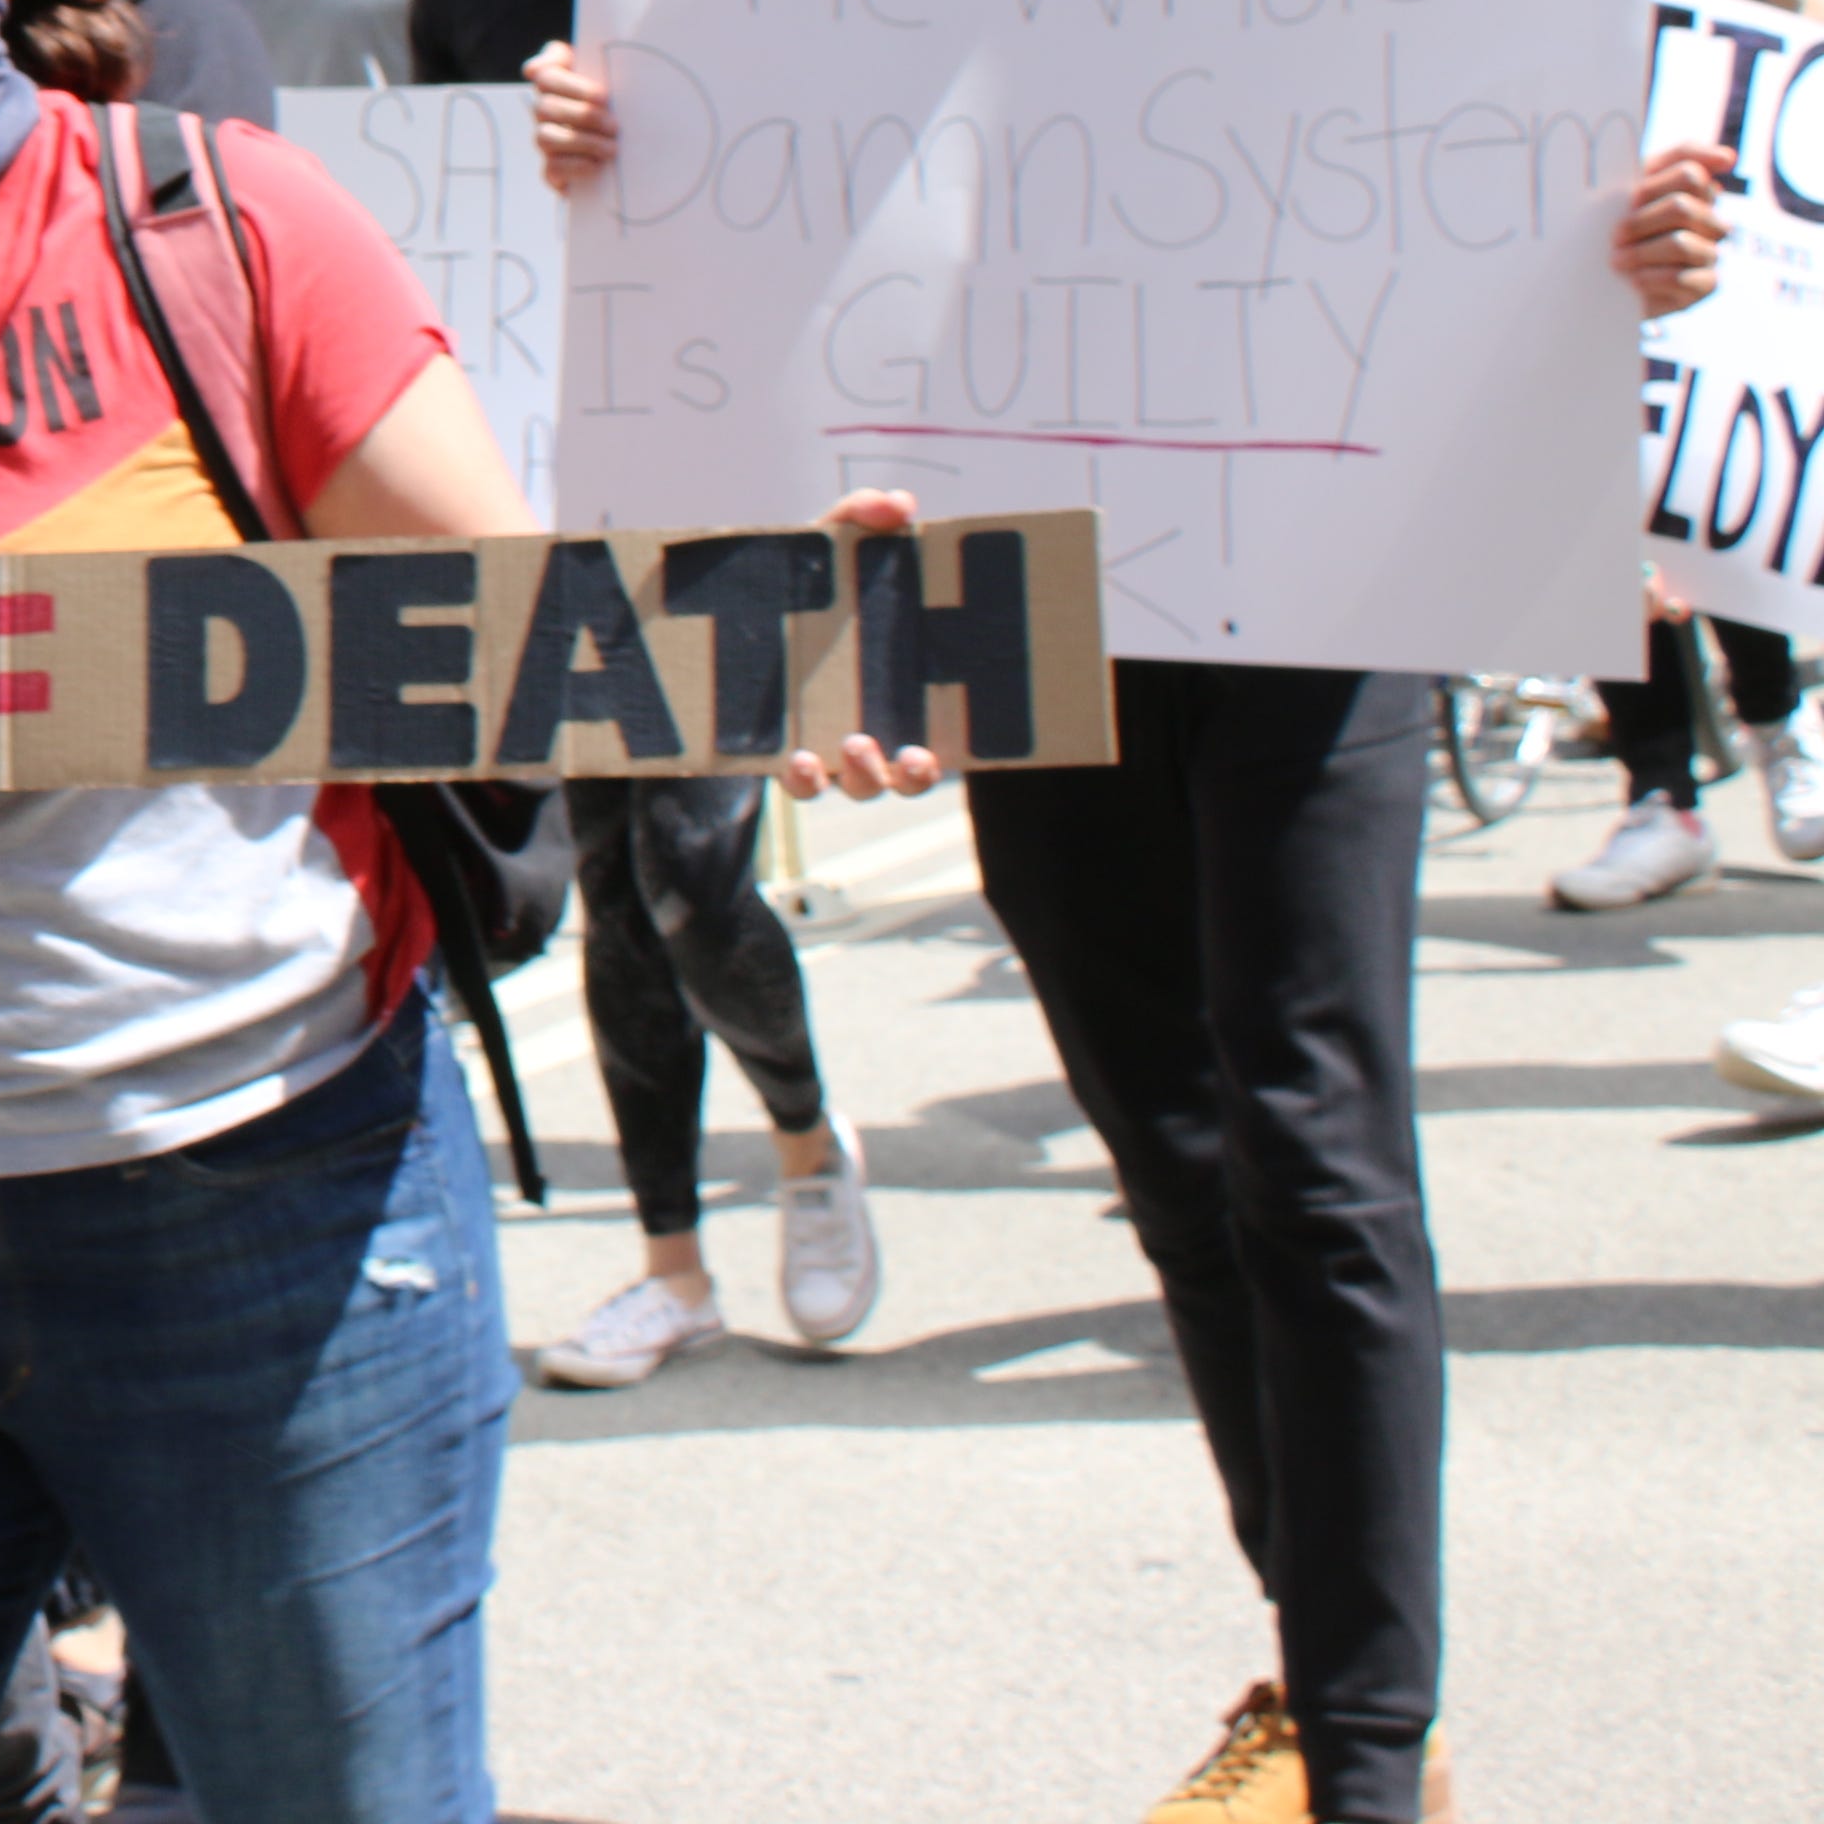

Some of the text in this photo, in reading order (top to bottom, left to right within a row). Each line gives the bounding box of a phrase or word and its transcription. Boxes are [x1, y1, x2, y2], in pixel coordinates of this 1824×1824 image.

[359, 87, 539, 245] SA
[601, 28, 1644, 296] Damn System
[569, 268, 1402, 458] Is GUILTY
[146, 529, 1039, 770] DEATH
